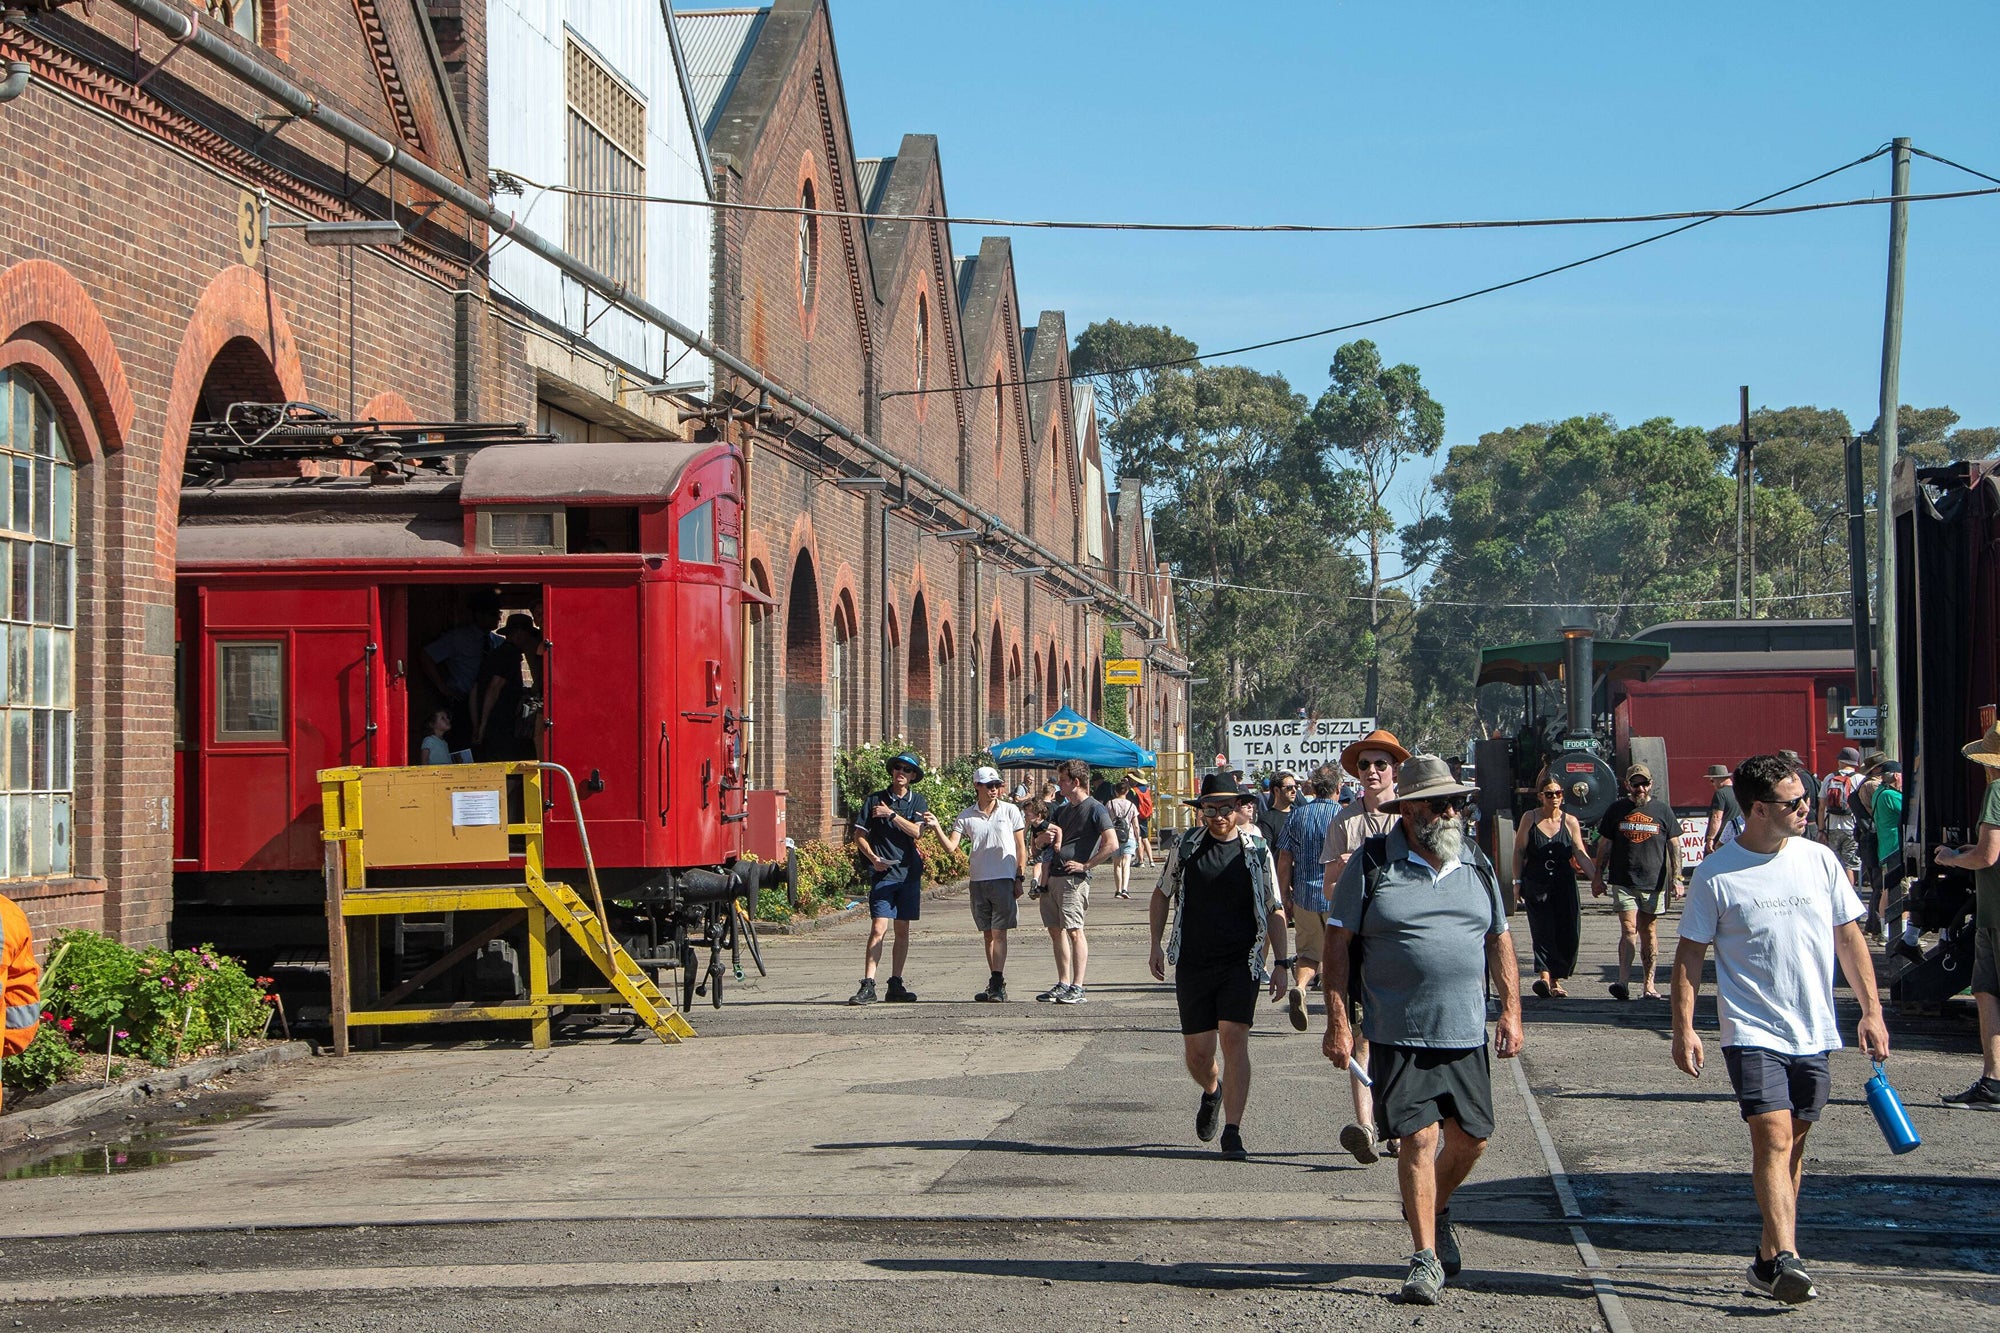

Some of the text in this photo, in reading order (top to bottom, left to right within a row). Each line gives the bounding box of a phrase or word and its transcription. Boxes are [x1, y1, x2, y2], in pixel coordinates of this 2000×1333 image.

[244, 202, 255, 249] 3
[1232, 721, 1370, 737] SAUSAGE SIZZLE
[1848, 719, 1868, 727] OPEN
[1000, 745, 1034, 758] Jaydee
[1244, 740, 1359, 755] TEA & COFFE
[1682, 837, 1704, 848] WAY
[1751, 895, 1813, 910] Article One
